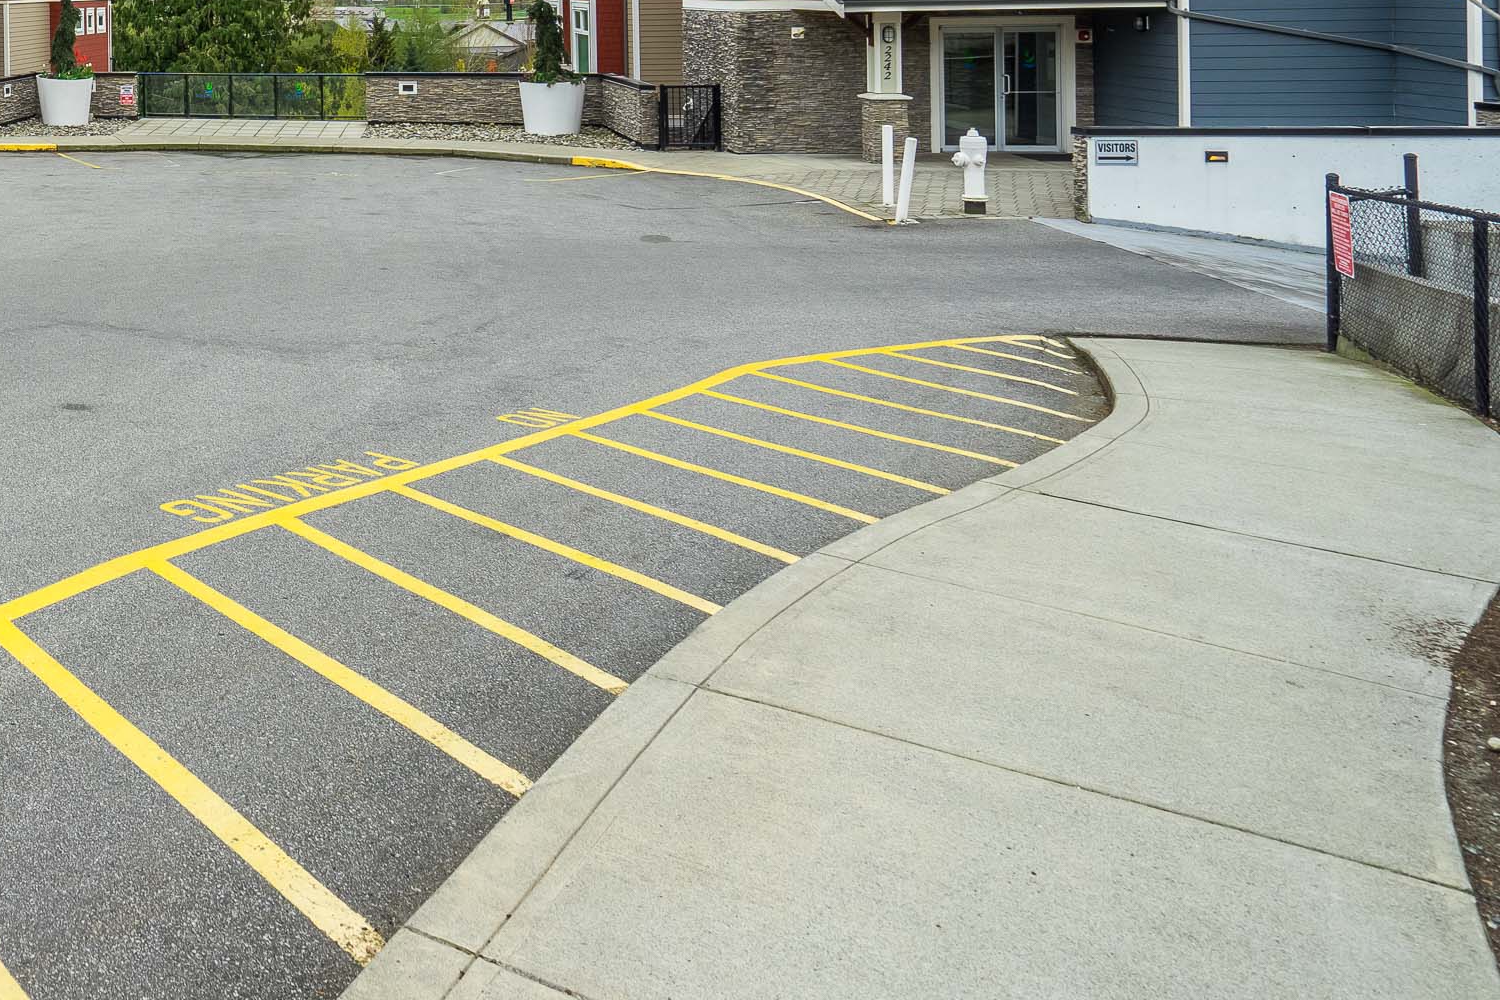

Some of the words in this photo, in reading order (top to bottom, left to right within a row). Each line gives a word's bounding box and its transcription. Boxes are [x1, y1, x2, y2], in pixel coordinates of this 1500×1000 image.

[884, 45, 892, 80] 2242
[1097, 142, 1136, 153] VISITORS
[495, 407, 582, 429] NO
[159, 450, 421, 524] PARKING
